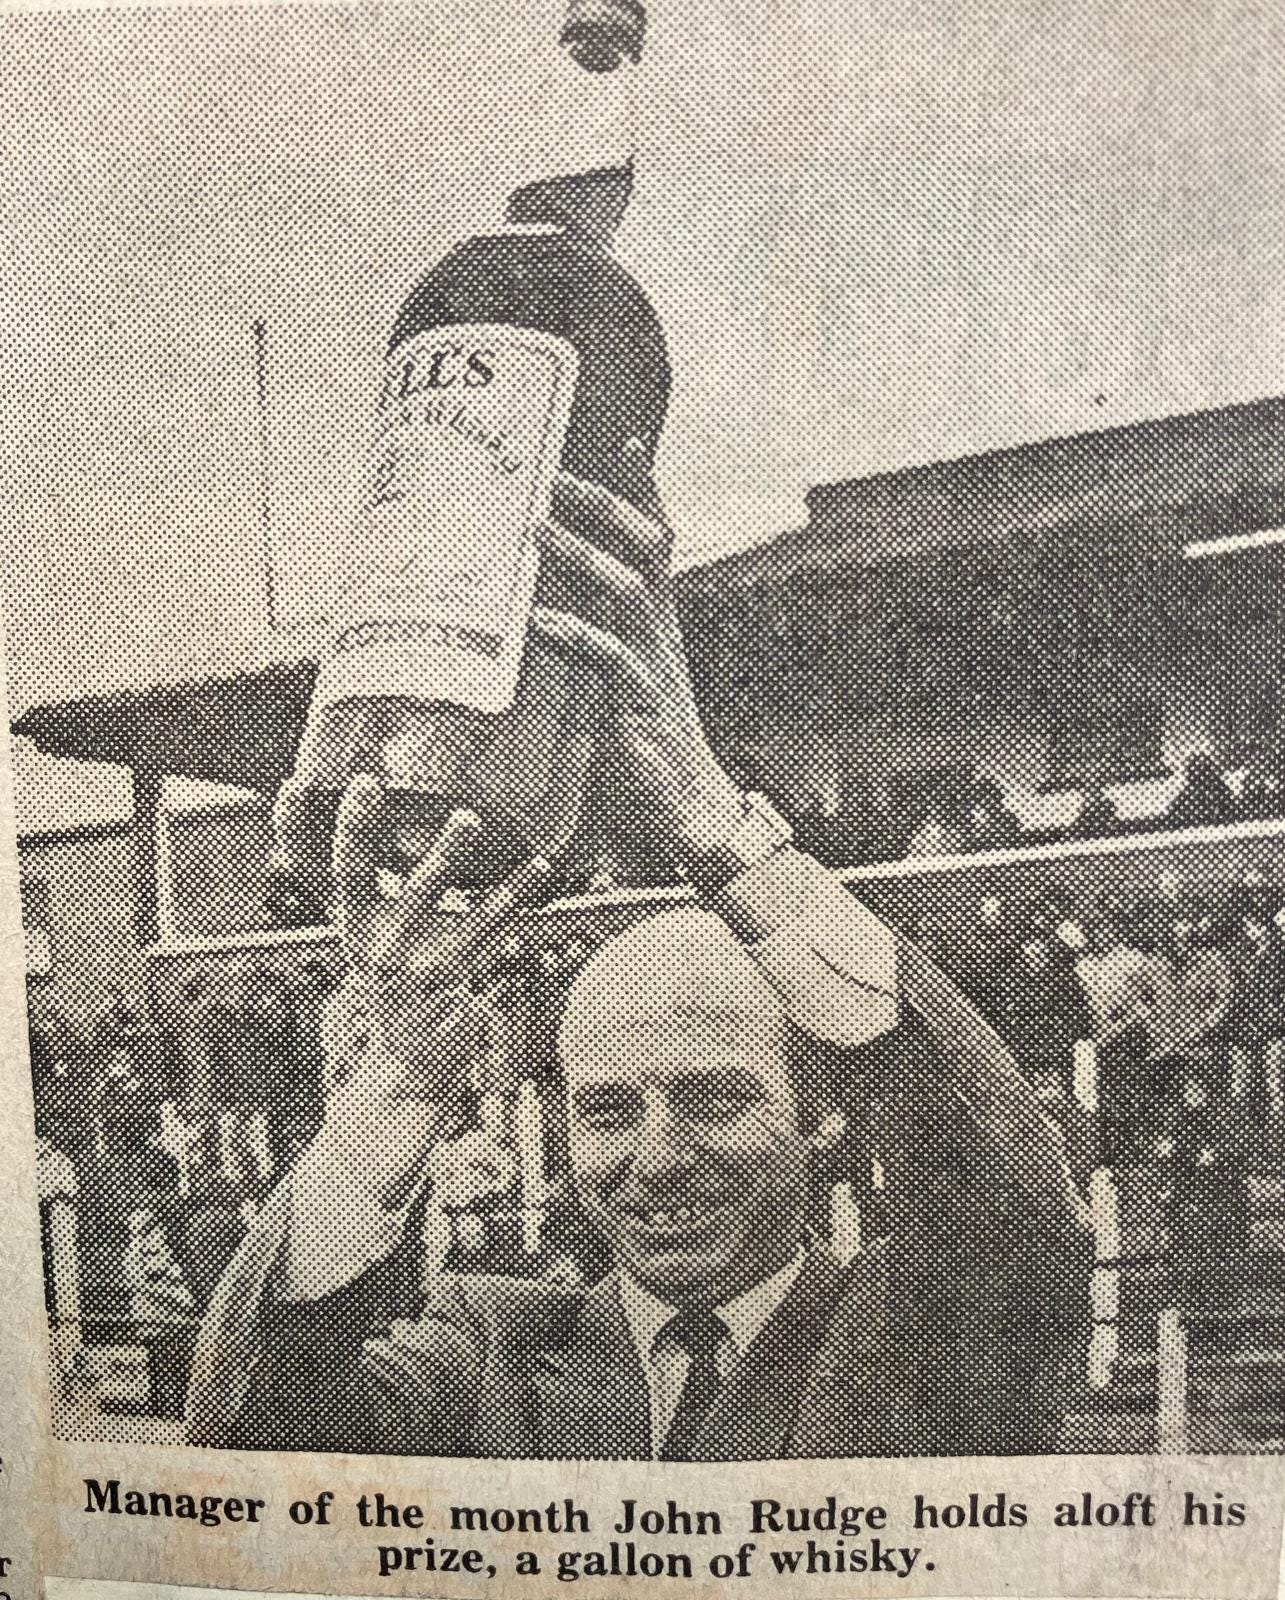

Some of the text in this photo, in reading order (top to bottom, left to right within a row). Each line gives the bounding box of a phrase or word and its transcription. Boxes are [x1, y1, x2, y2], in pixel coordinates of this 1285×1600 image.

[82, 1478, 1246, 1537] Manager of the month John Rudge holds aloft his
[377, 1538, 935, 1583] prize, a gallon of whisky.
